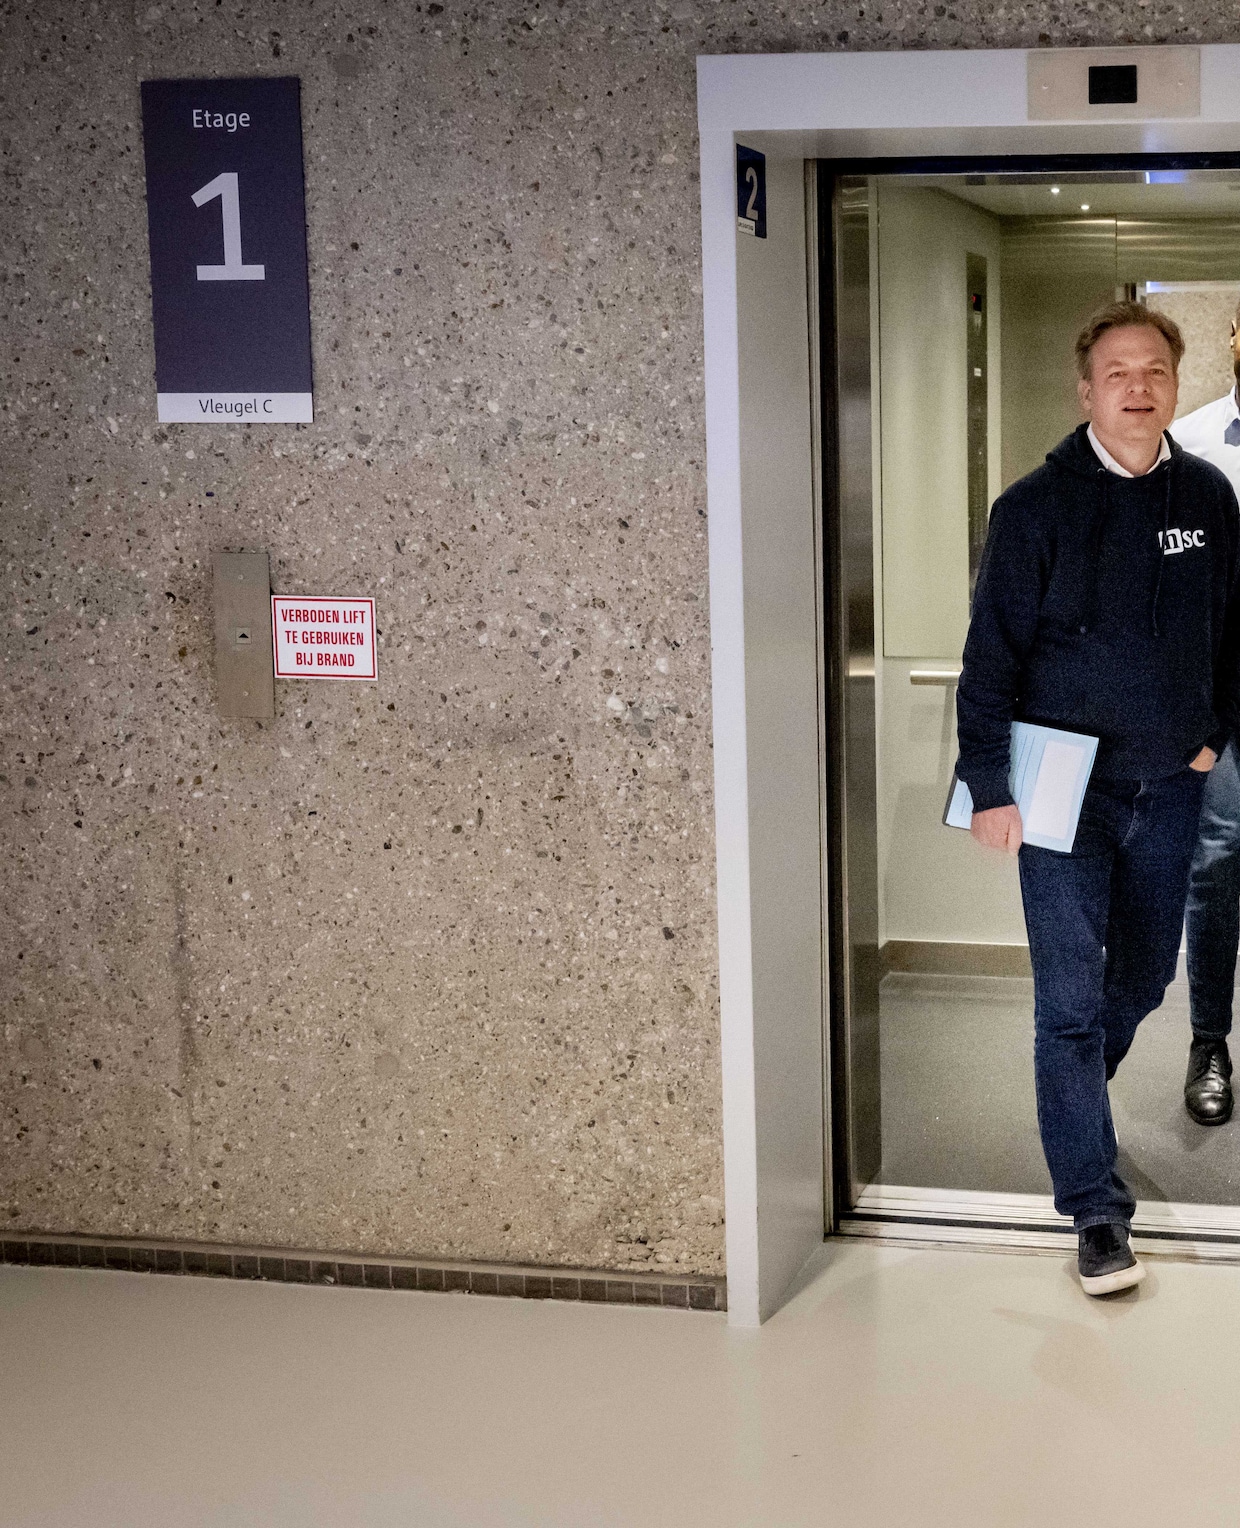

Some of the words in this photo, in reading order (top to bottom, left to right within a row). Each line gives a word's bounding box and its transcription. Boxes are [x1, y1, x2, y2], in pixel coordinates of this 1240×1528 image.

[193, 110, 250, 132] Etage
[746, 167, 759, 220] 2
[191, 173, 265, 280] 1
[199, 399, 257, 417] Vleugel
[263, 400, 272, 413] C
[282, 609, 339, 623] VERBODEN
[344, 611, 365, 623] LIFT
[285, 631, 298, 643] TE
[302, 631, 363, 645] GEBRUIKEN
[297, 653, 312, 665] BIJ
[318, 652, 354, 666] BRAND
